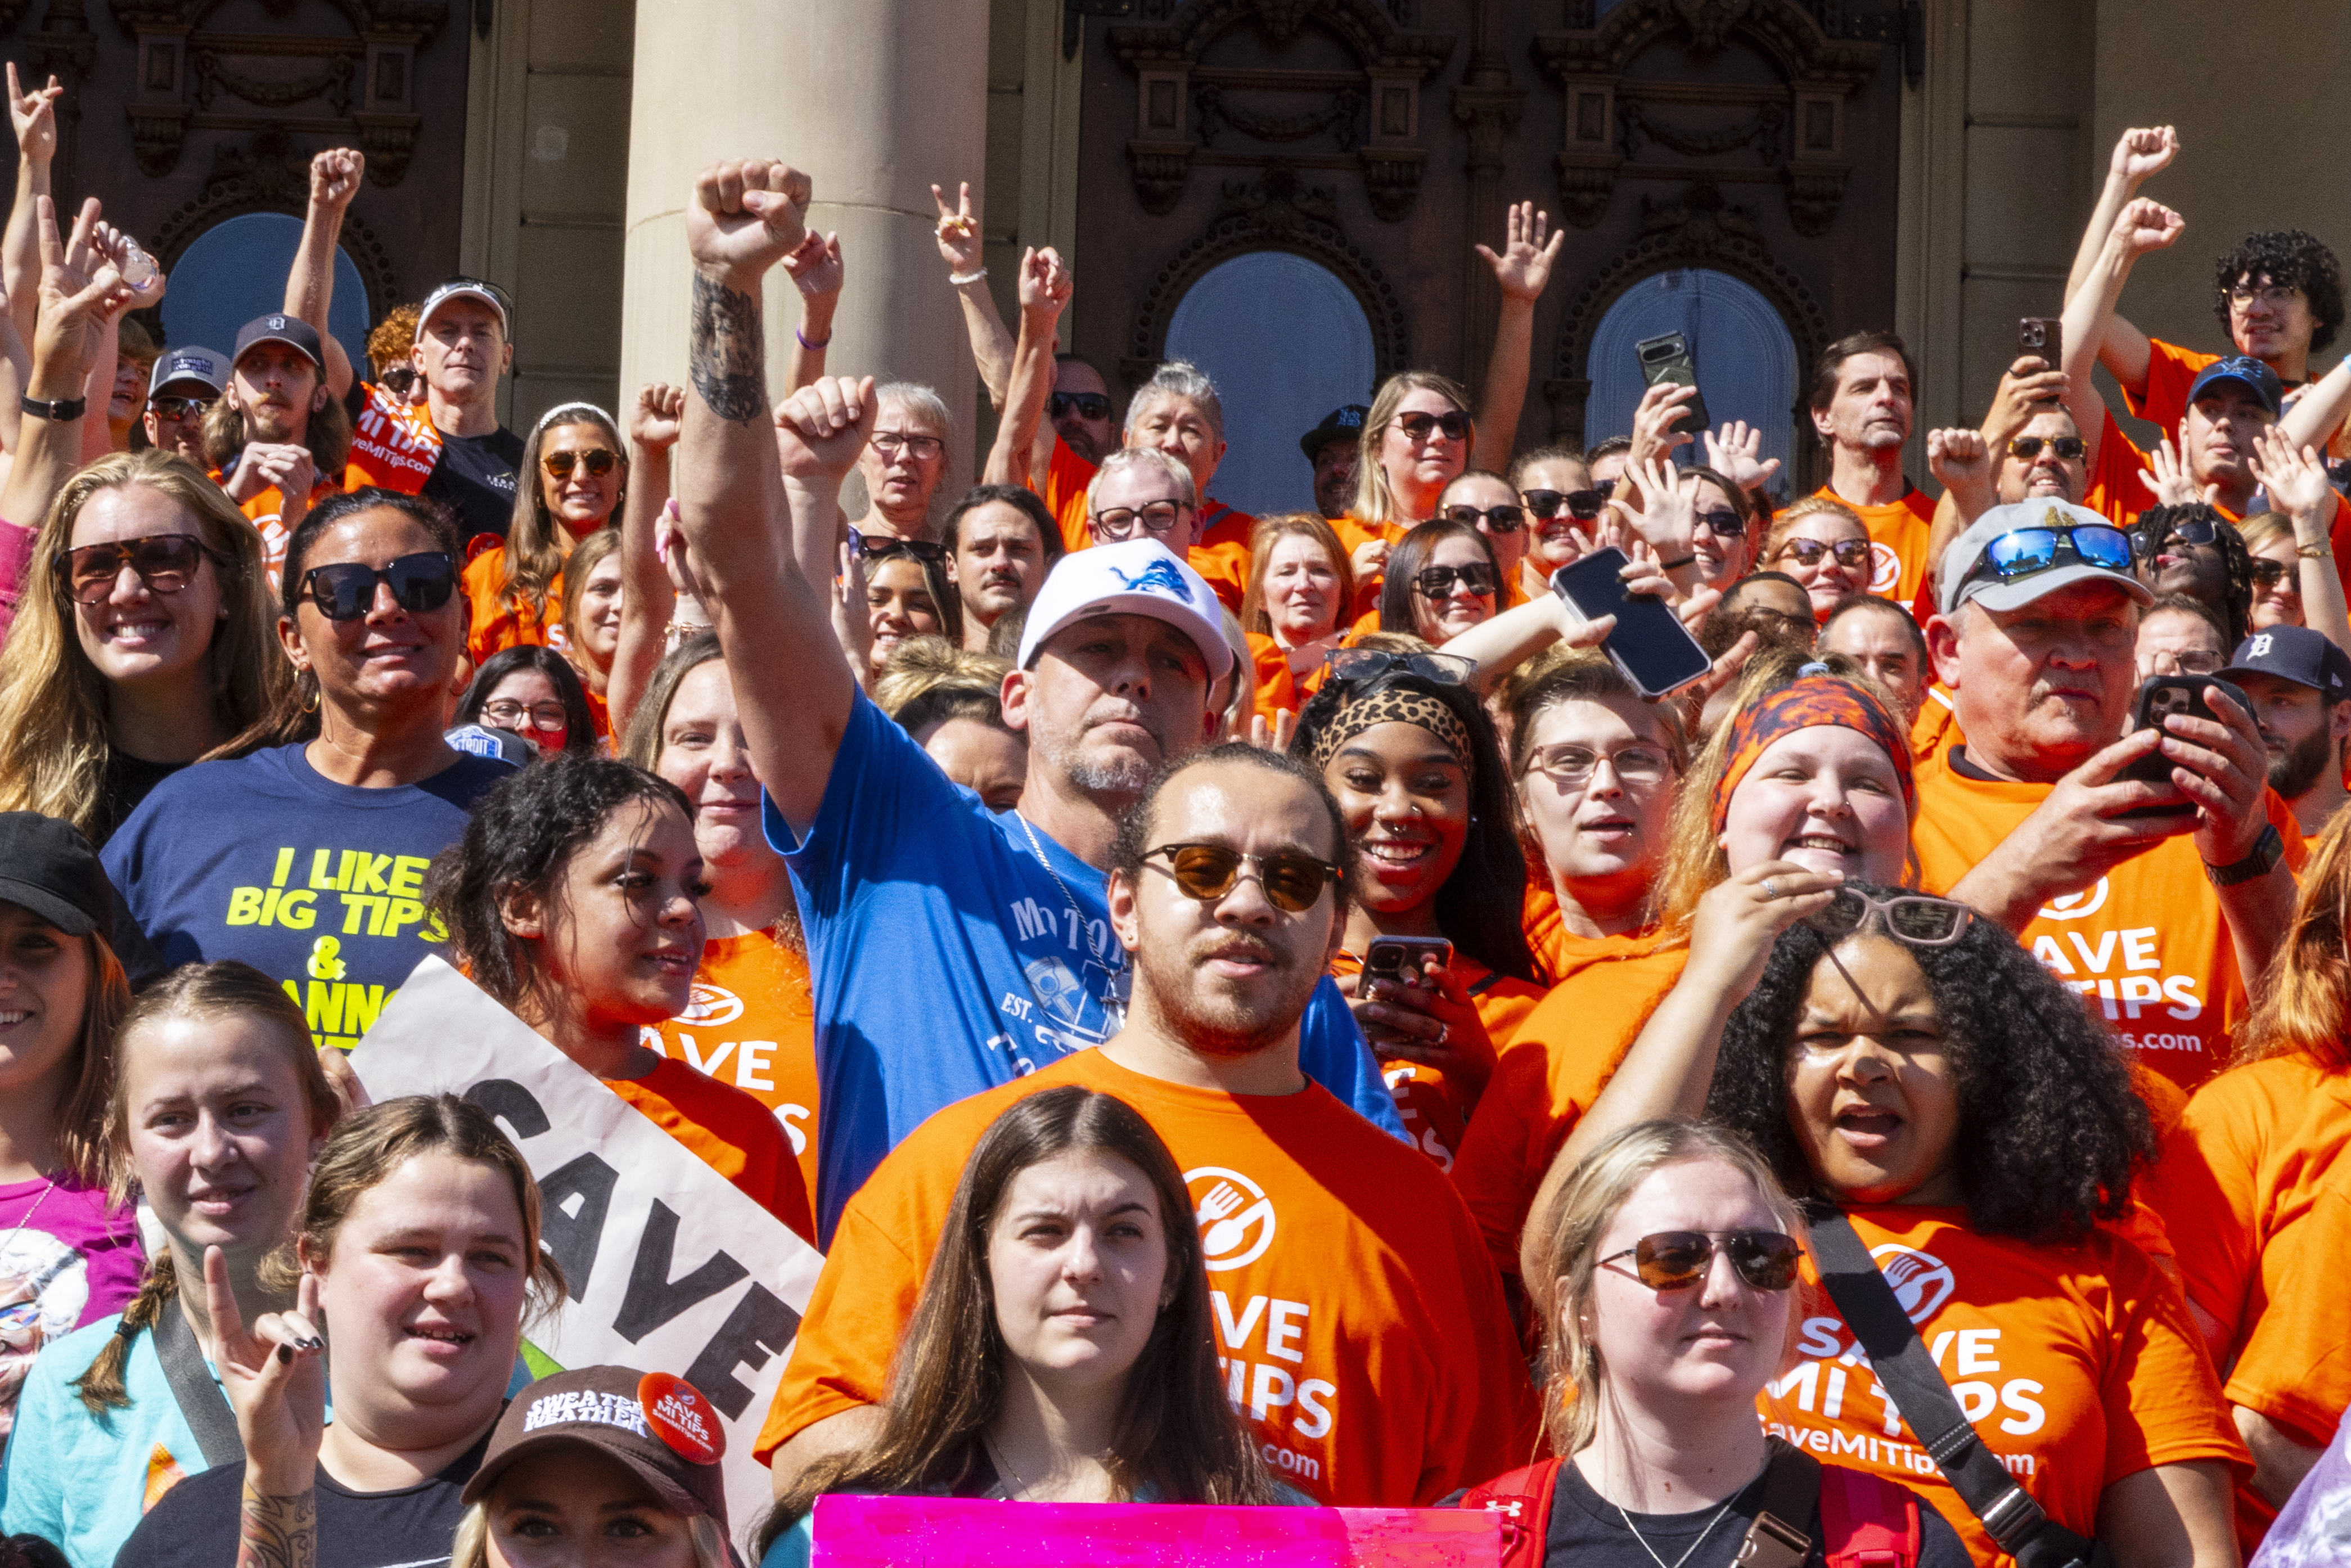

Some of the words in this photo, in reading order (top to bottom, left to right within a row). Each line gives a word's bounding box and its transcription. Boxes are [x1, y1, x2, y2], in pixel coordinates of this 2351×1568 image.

[352, 437, 433, 476] veMITips.com
[2246, 633, 2274, 662] D
[272, 847, 295, 887] I
[308, 848, 431, 899] LIKE
[226, 886, 318, 930] BIG
[340, 893, 450, 942] TIPS
[307, 935, 346, 981] &
[2032, 926, 2161, 974] AVE
[1000, 992, 1033, 1024] EST.
[639, 1026, 778, 1091] AVE
[1209, 1290, 1309, 1364] VE
[523, 1404, 647, 1438] WEATHER
[656, 1399, 675, 1420] MI
[678, 1412, 709, 1441] TIPS
[664, 1394, 702, 1428] SAVE
[1218, 1357, 1337, 1439] IPS
[1765, 1361, 1846, 1419] MI
[1870, 1378, 2046, 1438] TPS
